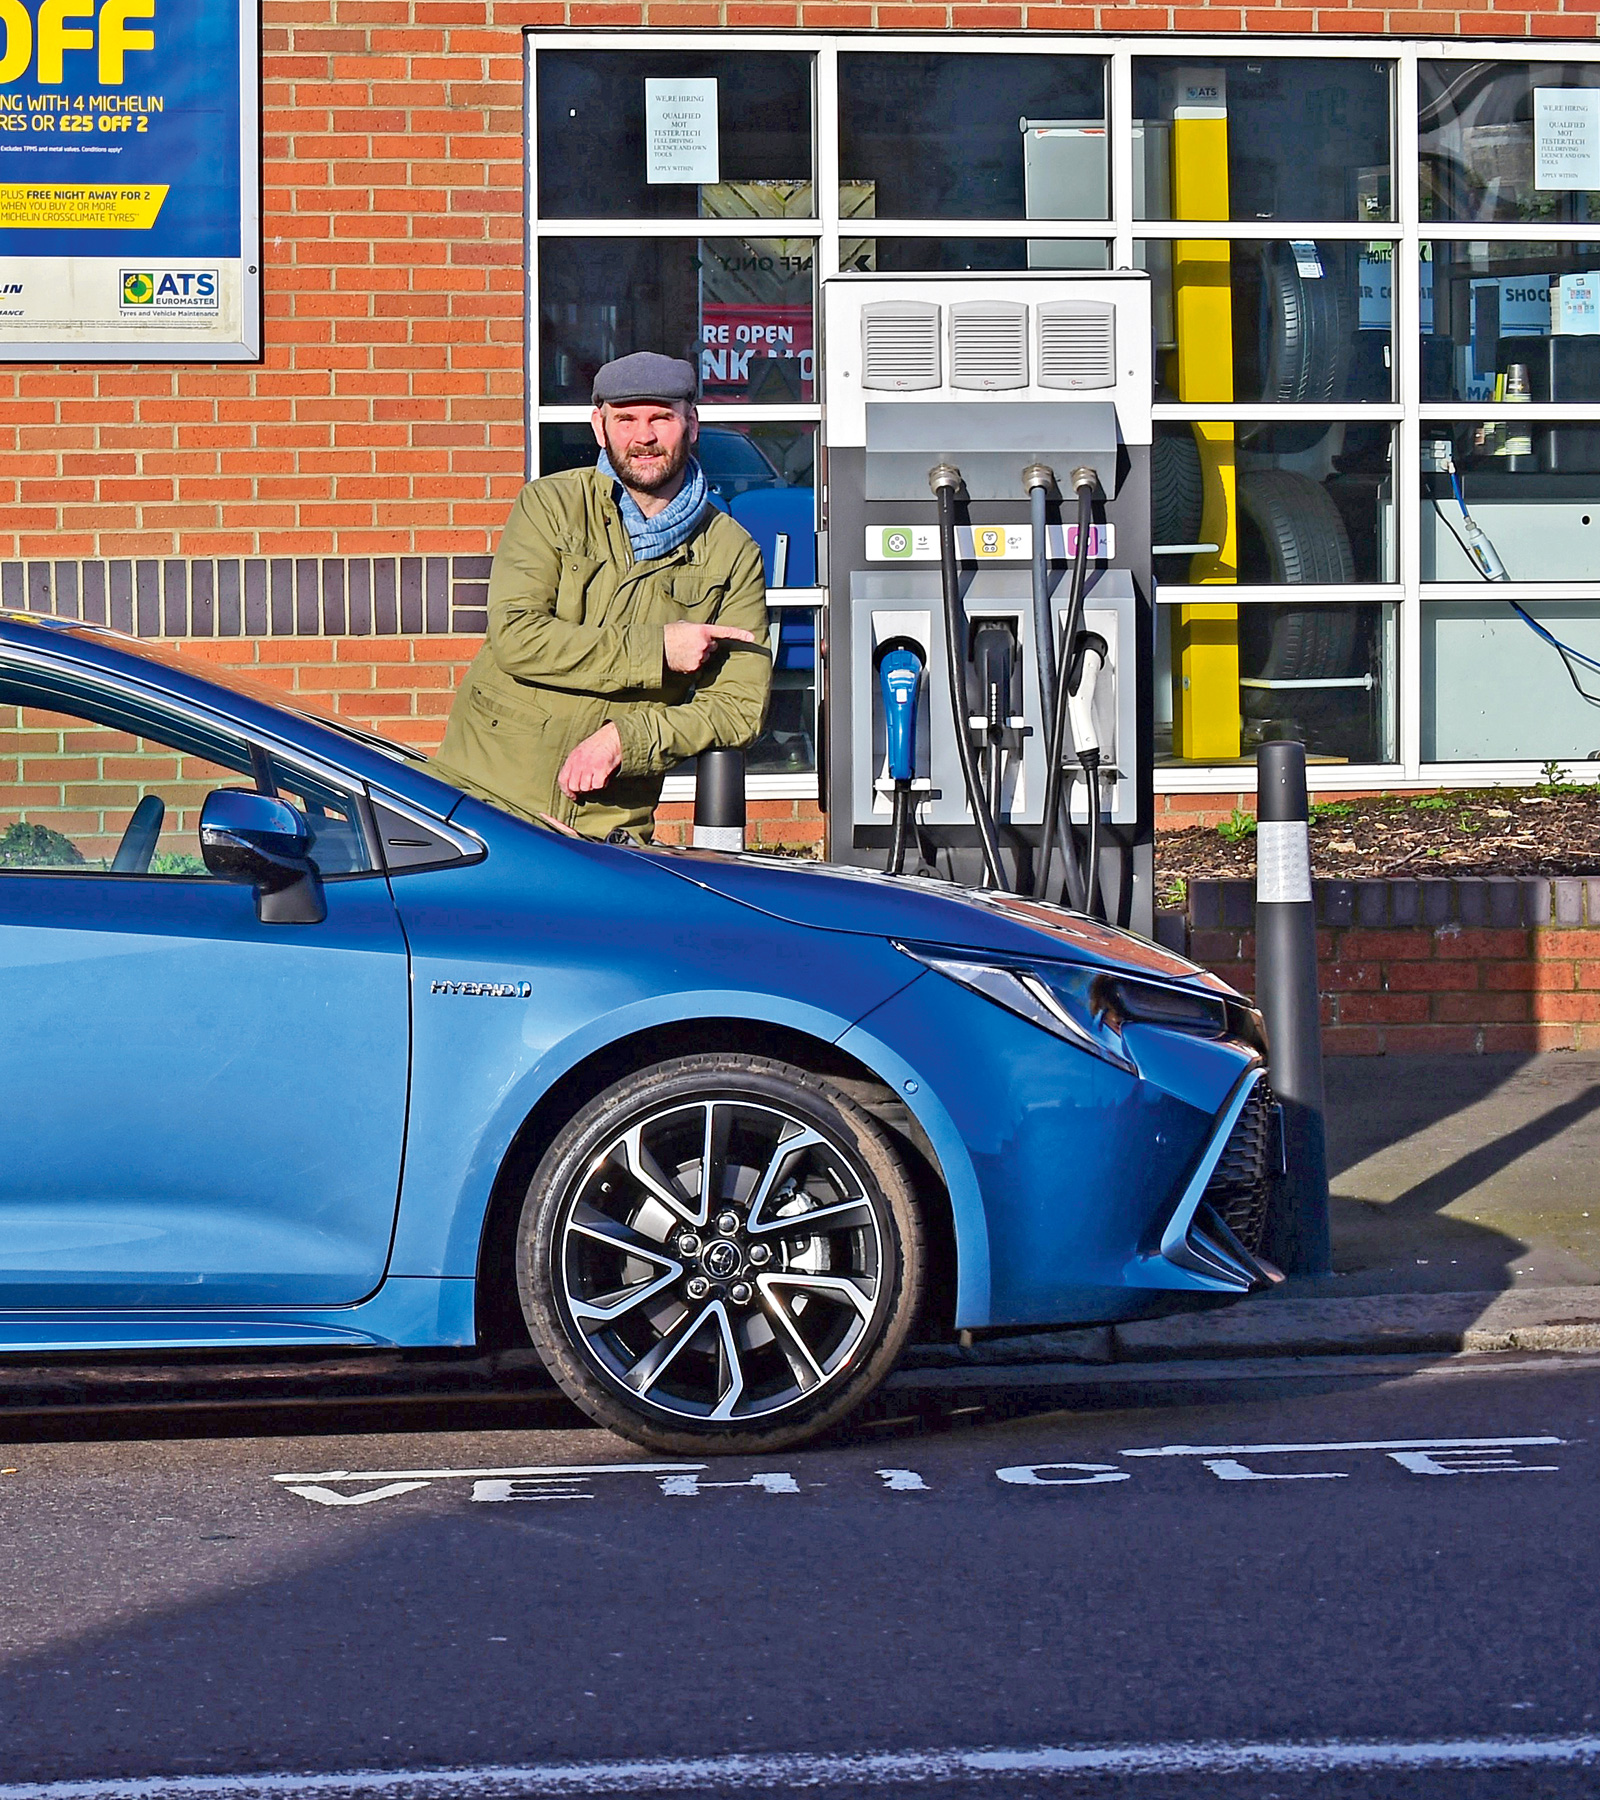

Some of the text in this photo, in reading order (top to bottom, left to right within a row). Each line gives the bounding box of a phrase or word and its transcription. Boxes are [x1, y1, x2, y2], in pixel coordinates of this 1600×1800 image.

[1198, 87, 1217, 96] ATS
[27, 95, 69, 111] WITH
[73, 95, 84, 111] 4
[89, 95, 164, 112] MICHELIN
[31, 114, 55, 131] OR
[60, 115, 94, 132] £25
[98, 115, 132, 132] OFF
[136, 116, 148, 132] 2
[0, 190, 150, 200] PLUS FREE NIGHT AWAY FOR 2
[0, 202, 116, 211] WHEN YOU BUY 2 OR MORE
[0, 212, 40, 221] MICHELIN
[43, 212, 105, 221] CROSSCLIMATE
[156, 273, 215, 296] ATS
[735, 325, 793, 344] OPEN
[431, 980, 517, 997] HYBRID
[289, 1449, 1559, 1506] VEHICLE
